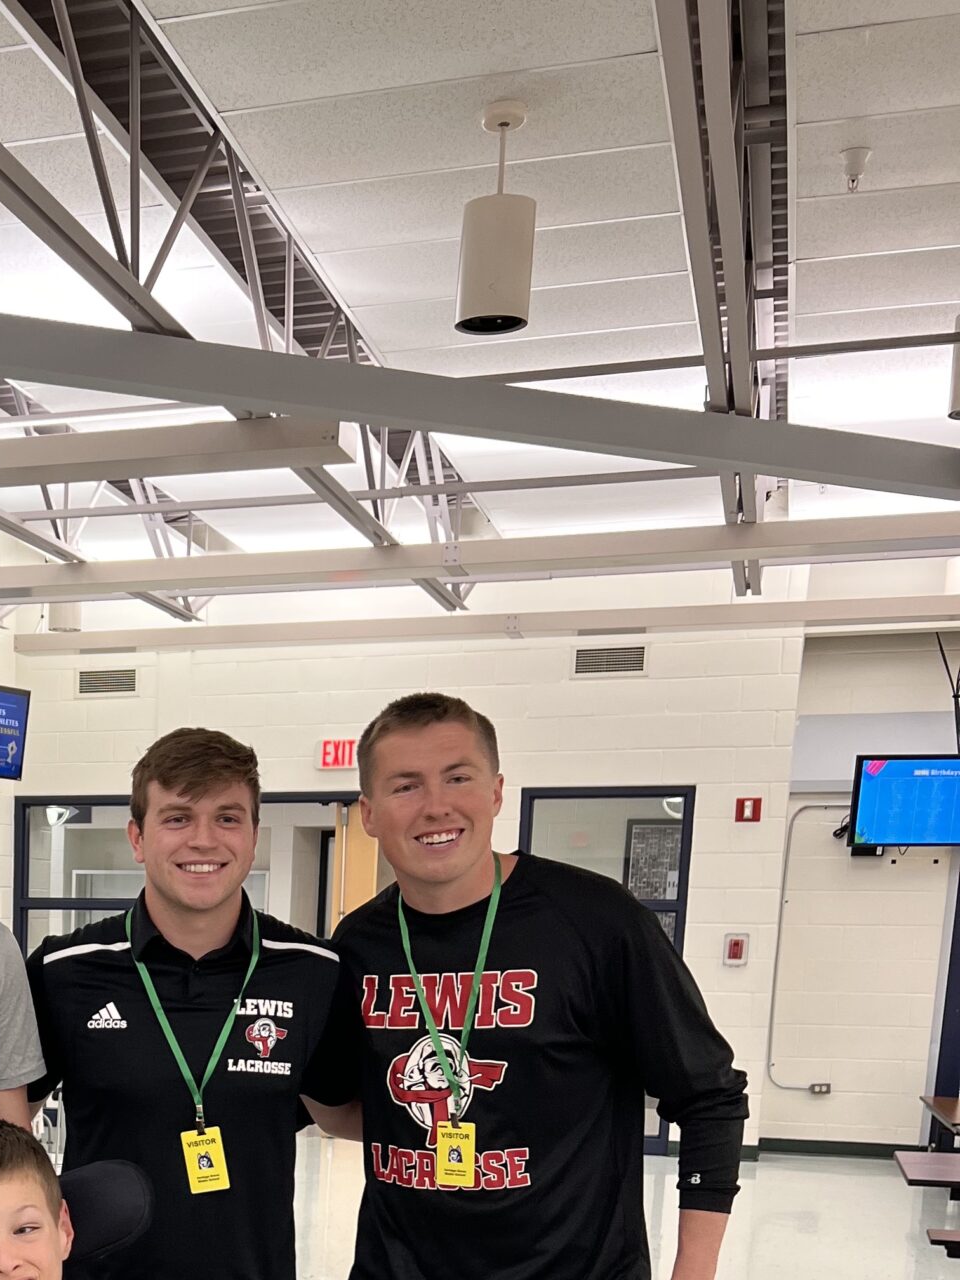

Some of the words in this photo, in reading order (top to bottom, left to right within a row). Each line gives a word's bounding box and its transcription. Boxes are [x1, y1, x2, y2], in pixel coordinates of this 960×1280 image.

[322, 740, 356, 767] EXIT
[234, 998, 293, 1018] LEWIS
[361, 969, 538, 1030] LEWIS
[87, 1017, 128, 1029] adidas
[227, 1058, 292, 1075] LACROSSE
[186, 1138, 217, 1148] VISITOR
[440, 1132, 470, 1141] VISITOR
[371, 1142, 531, 1190] LACRSE
